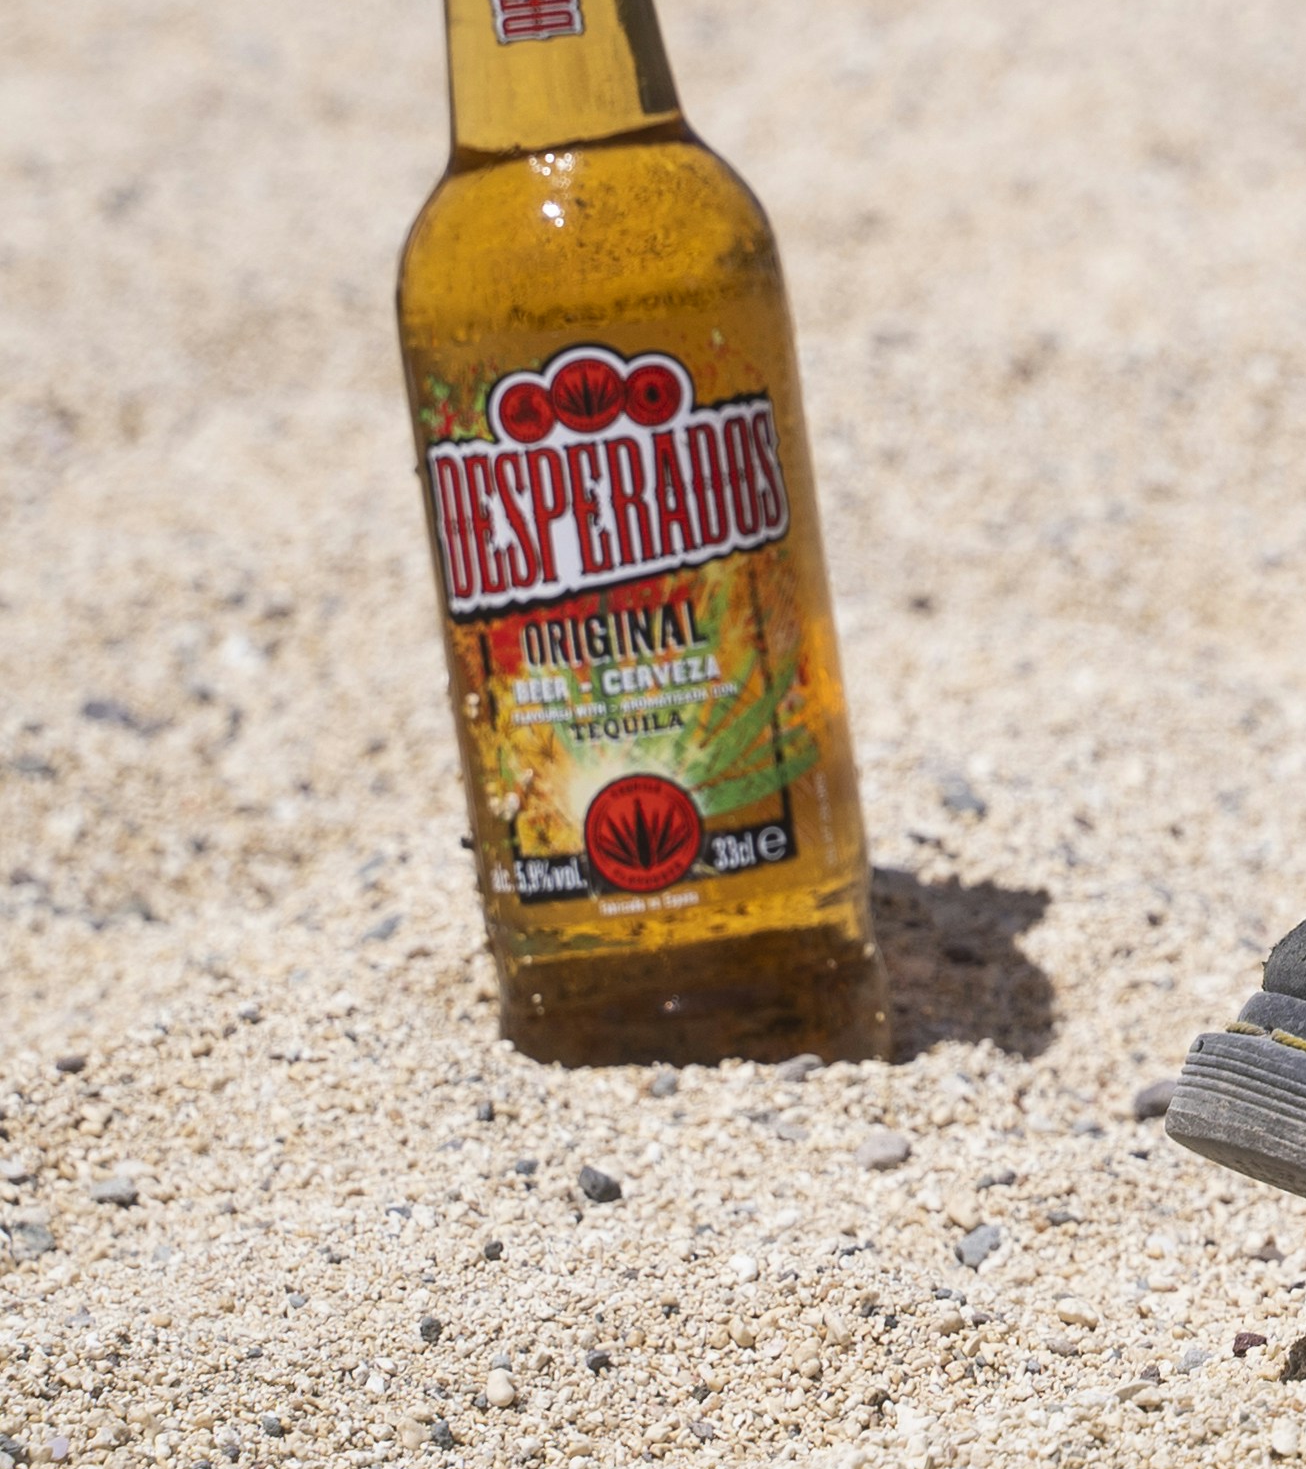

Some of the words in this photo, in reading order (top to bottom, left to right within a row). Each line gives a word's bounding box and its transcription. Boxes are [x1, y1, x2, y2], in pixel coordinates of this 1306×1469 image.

[434, 410, 784, 599] DESPERADOS
[521, 601, 709, 669] ORIGINAL
[513, 677, 568, 705] BEER
[602, 655, 721, 696] CERVEZA
[571, 710, 685, 742] TEQUILA
